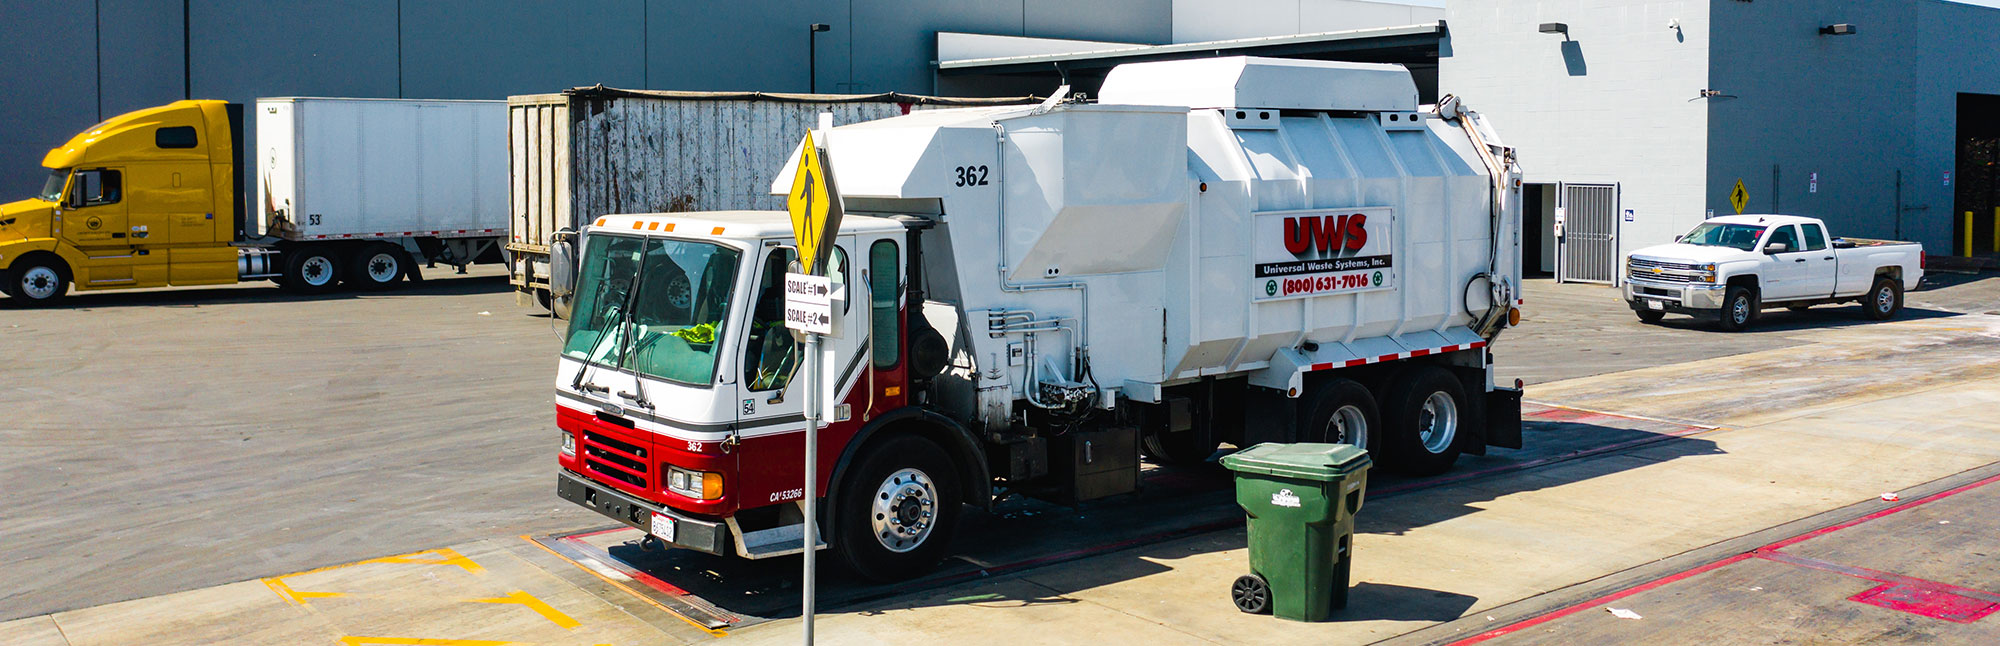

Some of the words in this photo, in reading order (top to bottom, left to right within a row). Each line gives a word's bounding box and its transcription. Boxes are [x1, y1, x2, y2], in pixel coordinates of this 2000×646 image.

[955, 165, 988, 187] 362
[1284, 213, 1367, 254] UWS
[1263, 261, 1305, 274] Universal
[1307, 260, 1333, 271] Waste
[1335, 257, 1370, 271] Systems,
[1371, 257, 1386, 267] Inc.
[787, 280, 807, 295] SCALE
[787, 308, 807, 323] SCALE
[744, 403, 754, 414] 54
[687, 441, 703, 452] 362
